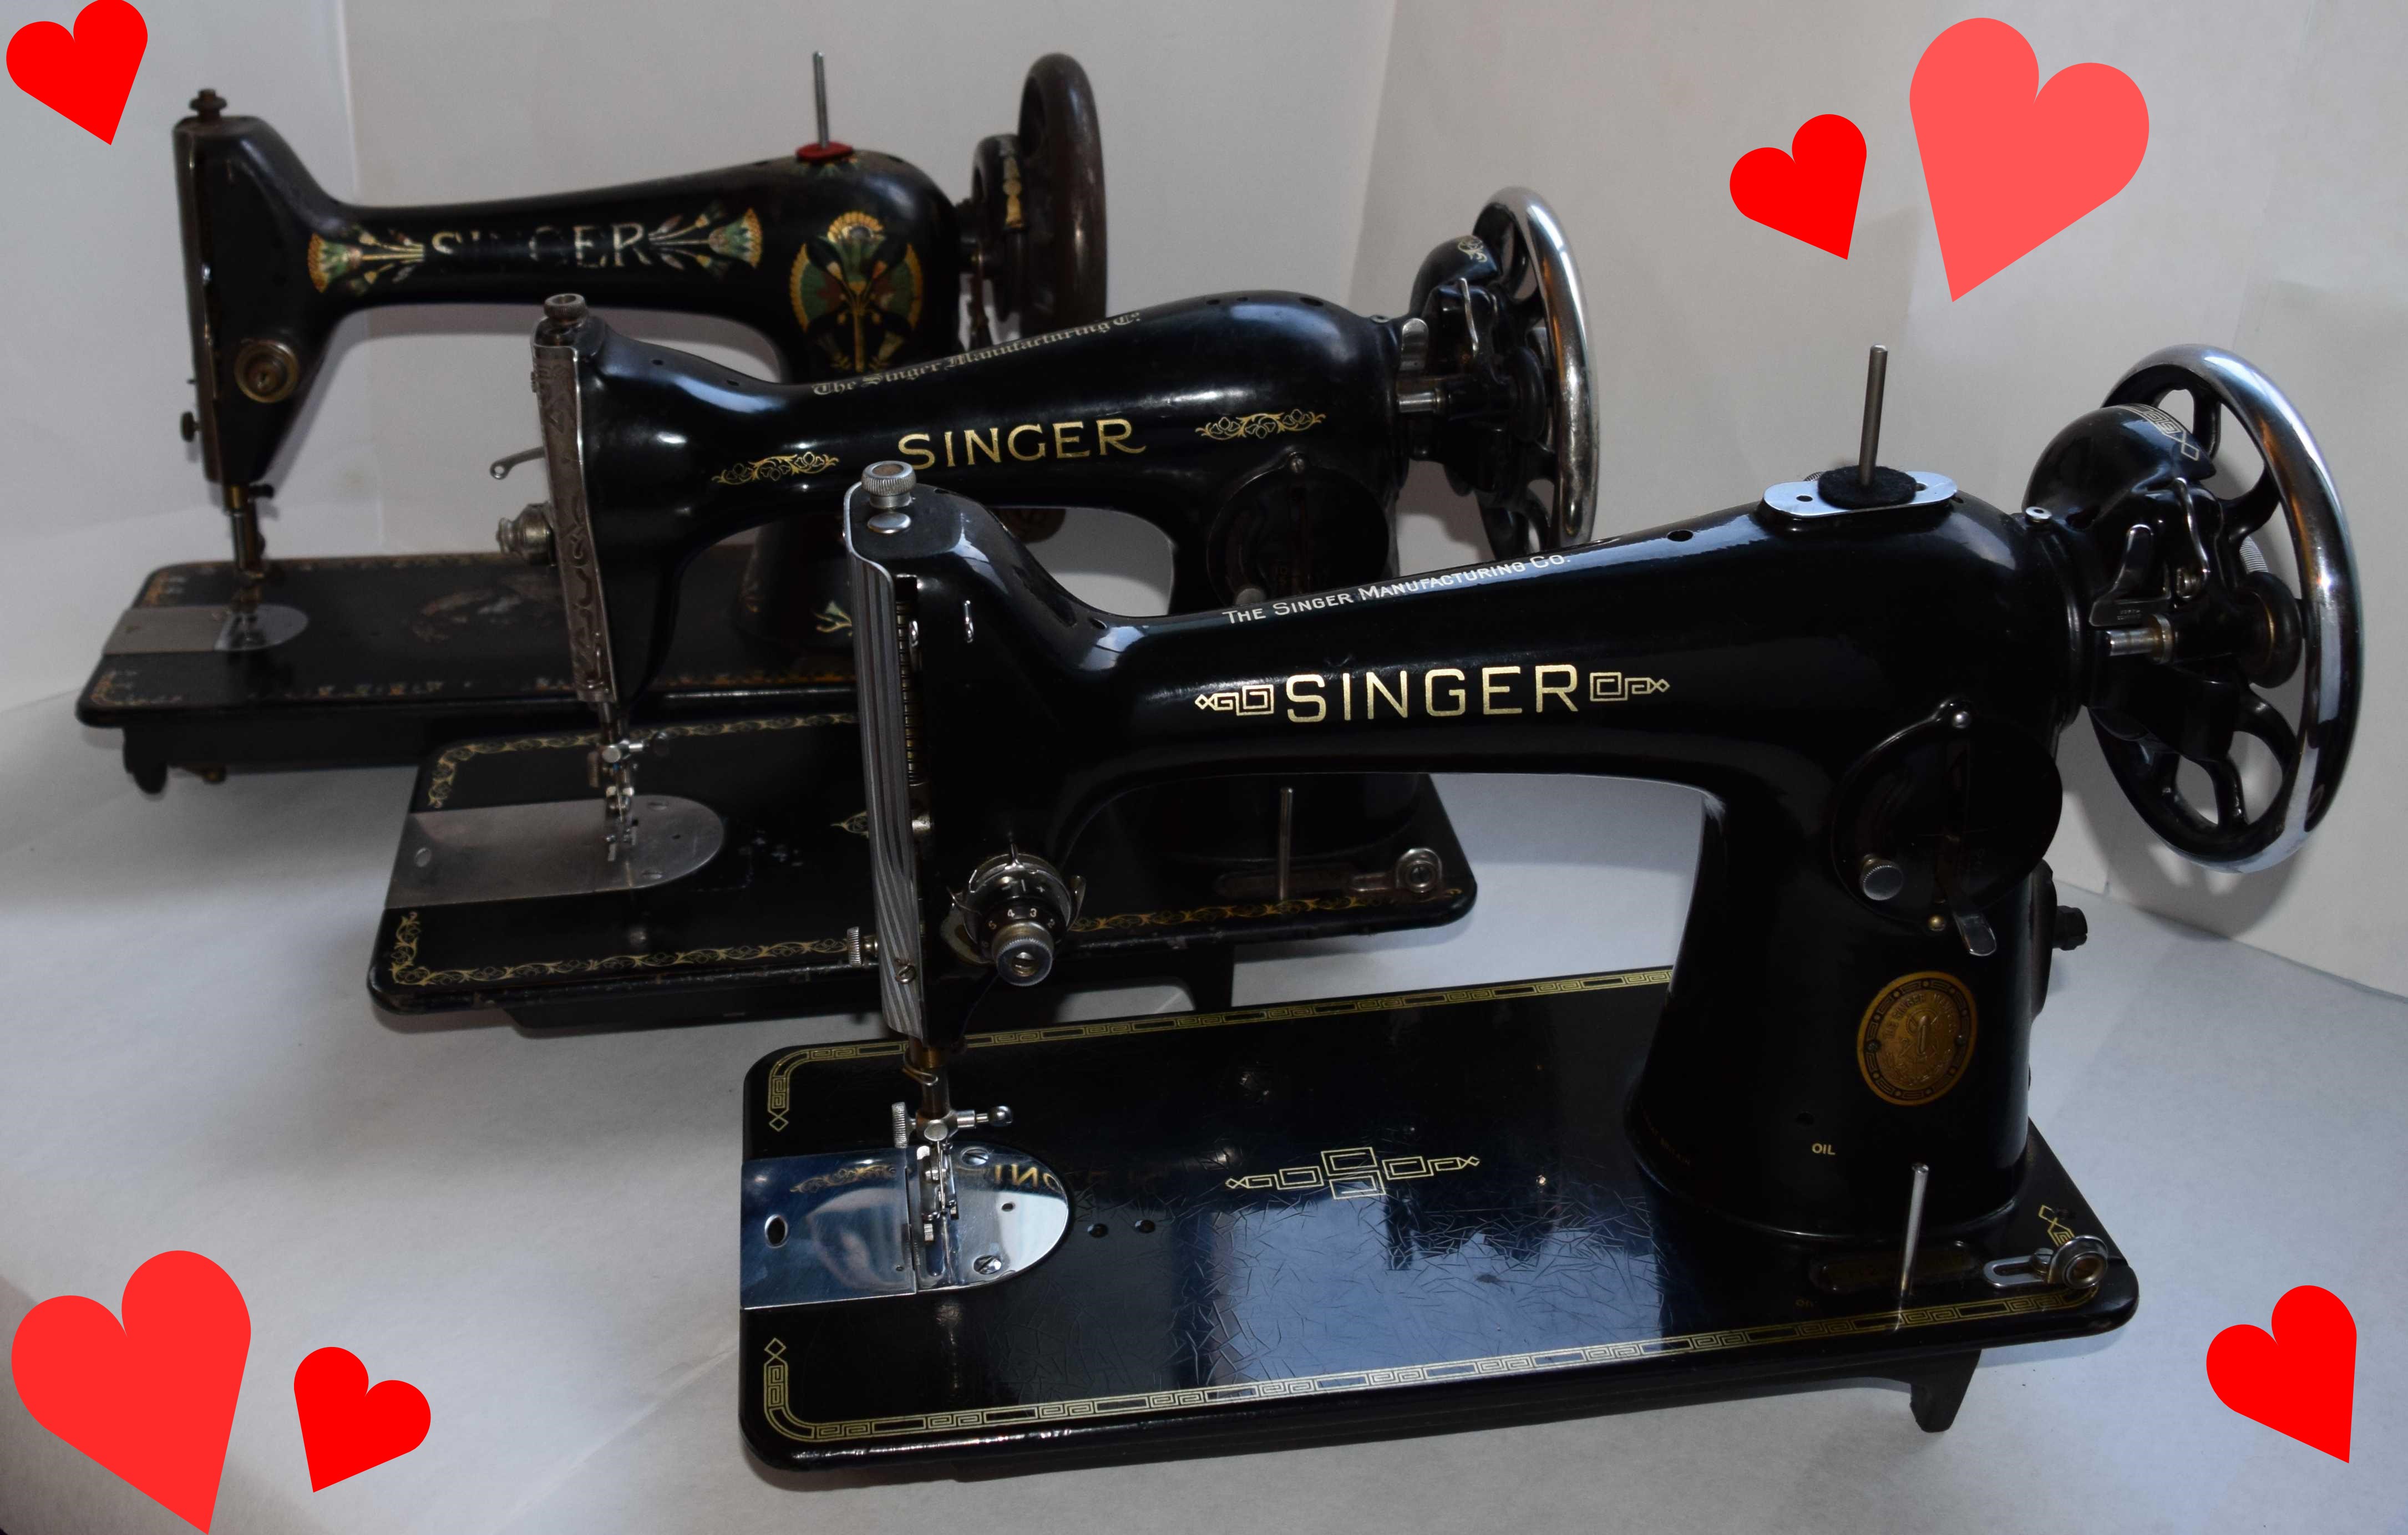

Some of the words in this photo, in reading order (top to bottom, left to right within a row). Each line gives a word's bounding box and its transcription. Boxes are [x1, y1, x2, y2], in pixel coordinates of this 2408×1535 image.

[432, 222, 653, 268] SGER
[812, 382, 857, 395] The
[898, 418, 1147, 470] SINGER
[1222, 608, 1266, 624] THE
[1273, 593, 1354, 616] SINGER
[1358, 561, 1526, 601] MANUFACTURING
[1286, 664, 1579, 723] SINGER
[1007, 908, 1016, 918] 4
[1030, 908, 1037, 918] 3
[1811, 1142, 1837, 1156] OIL
